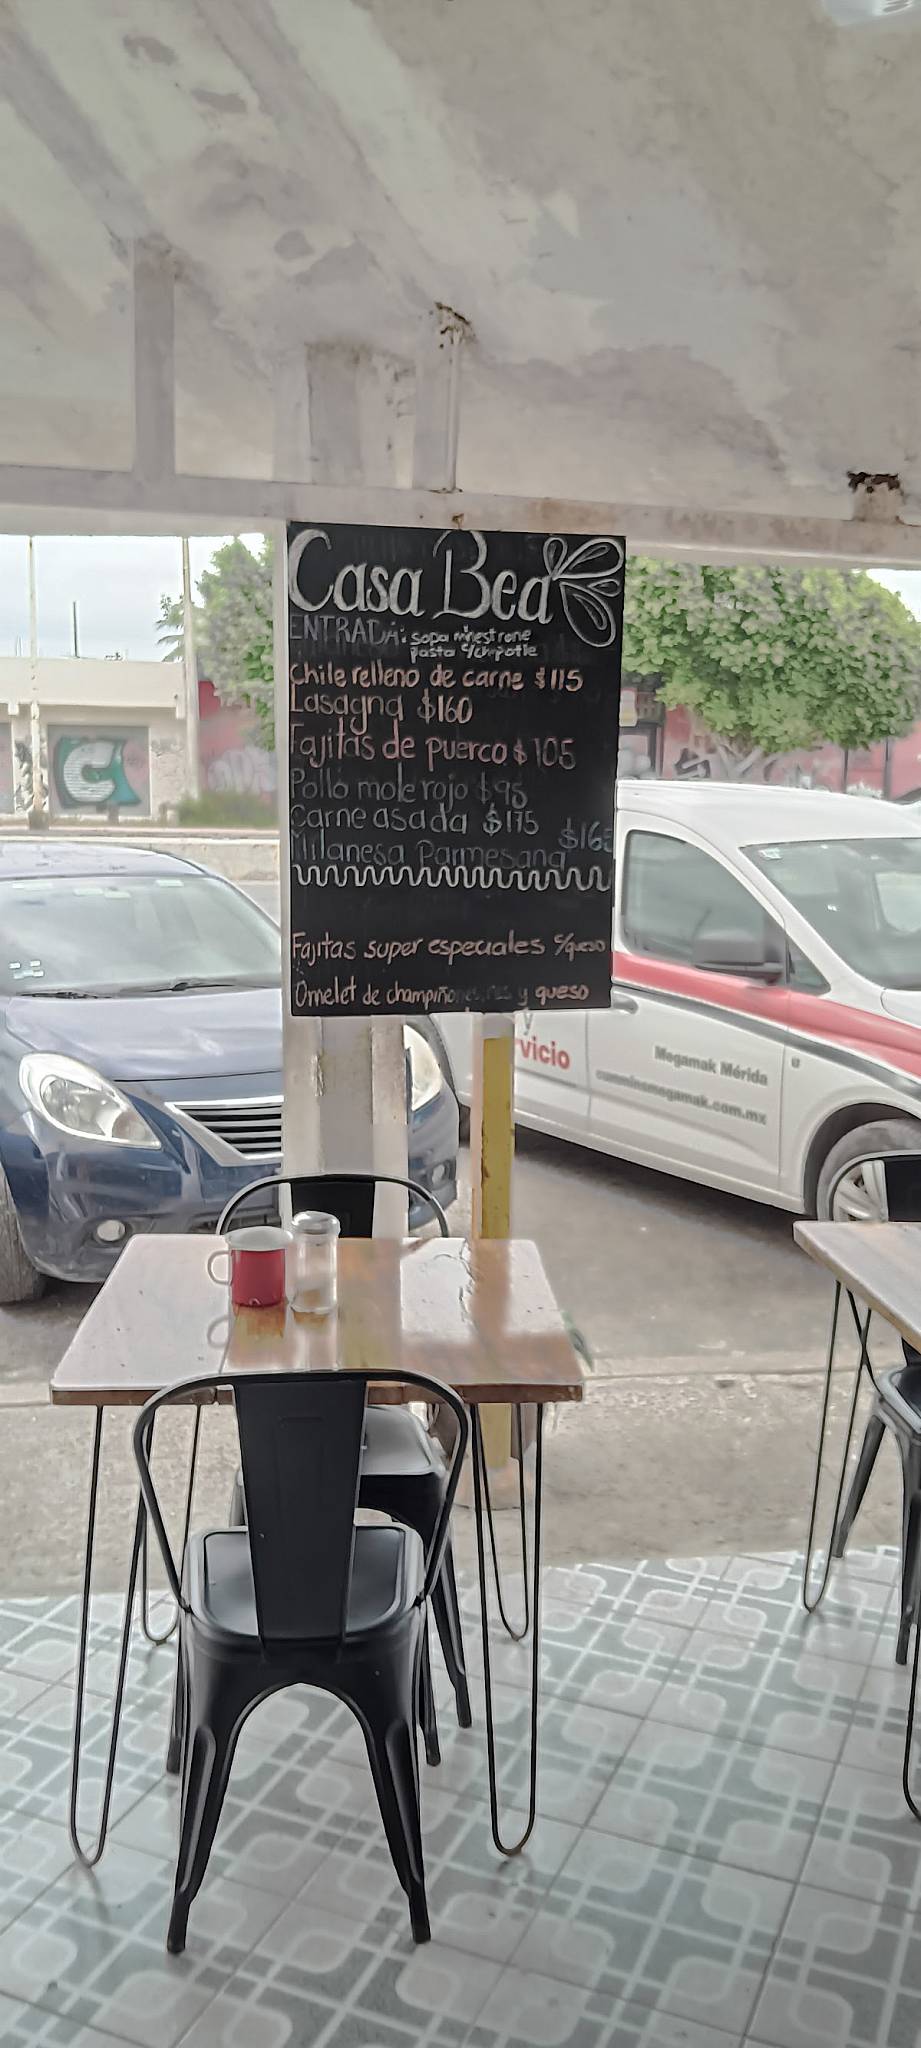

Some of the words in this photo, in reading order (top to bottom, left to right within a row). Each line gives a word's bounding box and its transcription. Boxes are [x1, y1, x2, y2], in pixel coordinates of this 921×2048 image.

[289, 529, 425, 617] Casa
[432, 529, 553, 624] Bea
[410, 631, 450, 647] sopa
[410, 645, 456, 664] pasta
[290, 662, 347, 688] Chile
[352, 660, 420, 689] relleno
[430, 664, 456, 689] de
[463, 668, 525, 690] carne
[291, 684, 405, 735] Lasagna
[417, 688, 473, 724] $160
[291, 717, 375, 768] Fajitas
[382, 719, 416, 759] de
[425, 735, 507, 771] puerco
[291, 767, 349, 800] Pollo
[357, 762, 416, 803] mole
[422, 773, 468, 811] rojo
[290, 804, 367, 830] Carne
[373, 803, 468, 834] asada
[291, 828, 406, 865] Milanesa
[416, 839, 566, 872] Parmesana
[291, 932, 356, 967] Fajitas
[364, 938, 422, 965] super
[428, 930, 545, 965] especiales
[296, 976, 356, 1008] Omelet
[362, 983, 381, 1006] de
[517, 986, 528, 1006] y
[535, 984, 590, 1006] queso
[654, 1046, 716, 1075] Megamak
[720, 1061, 768, 1087] Mérida
